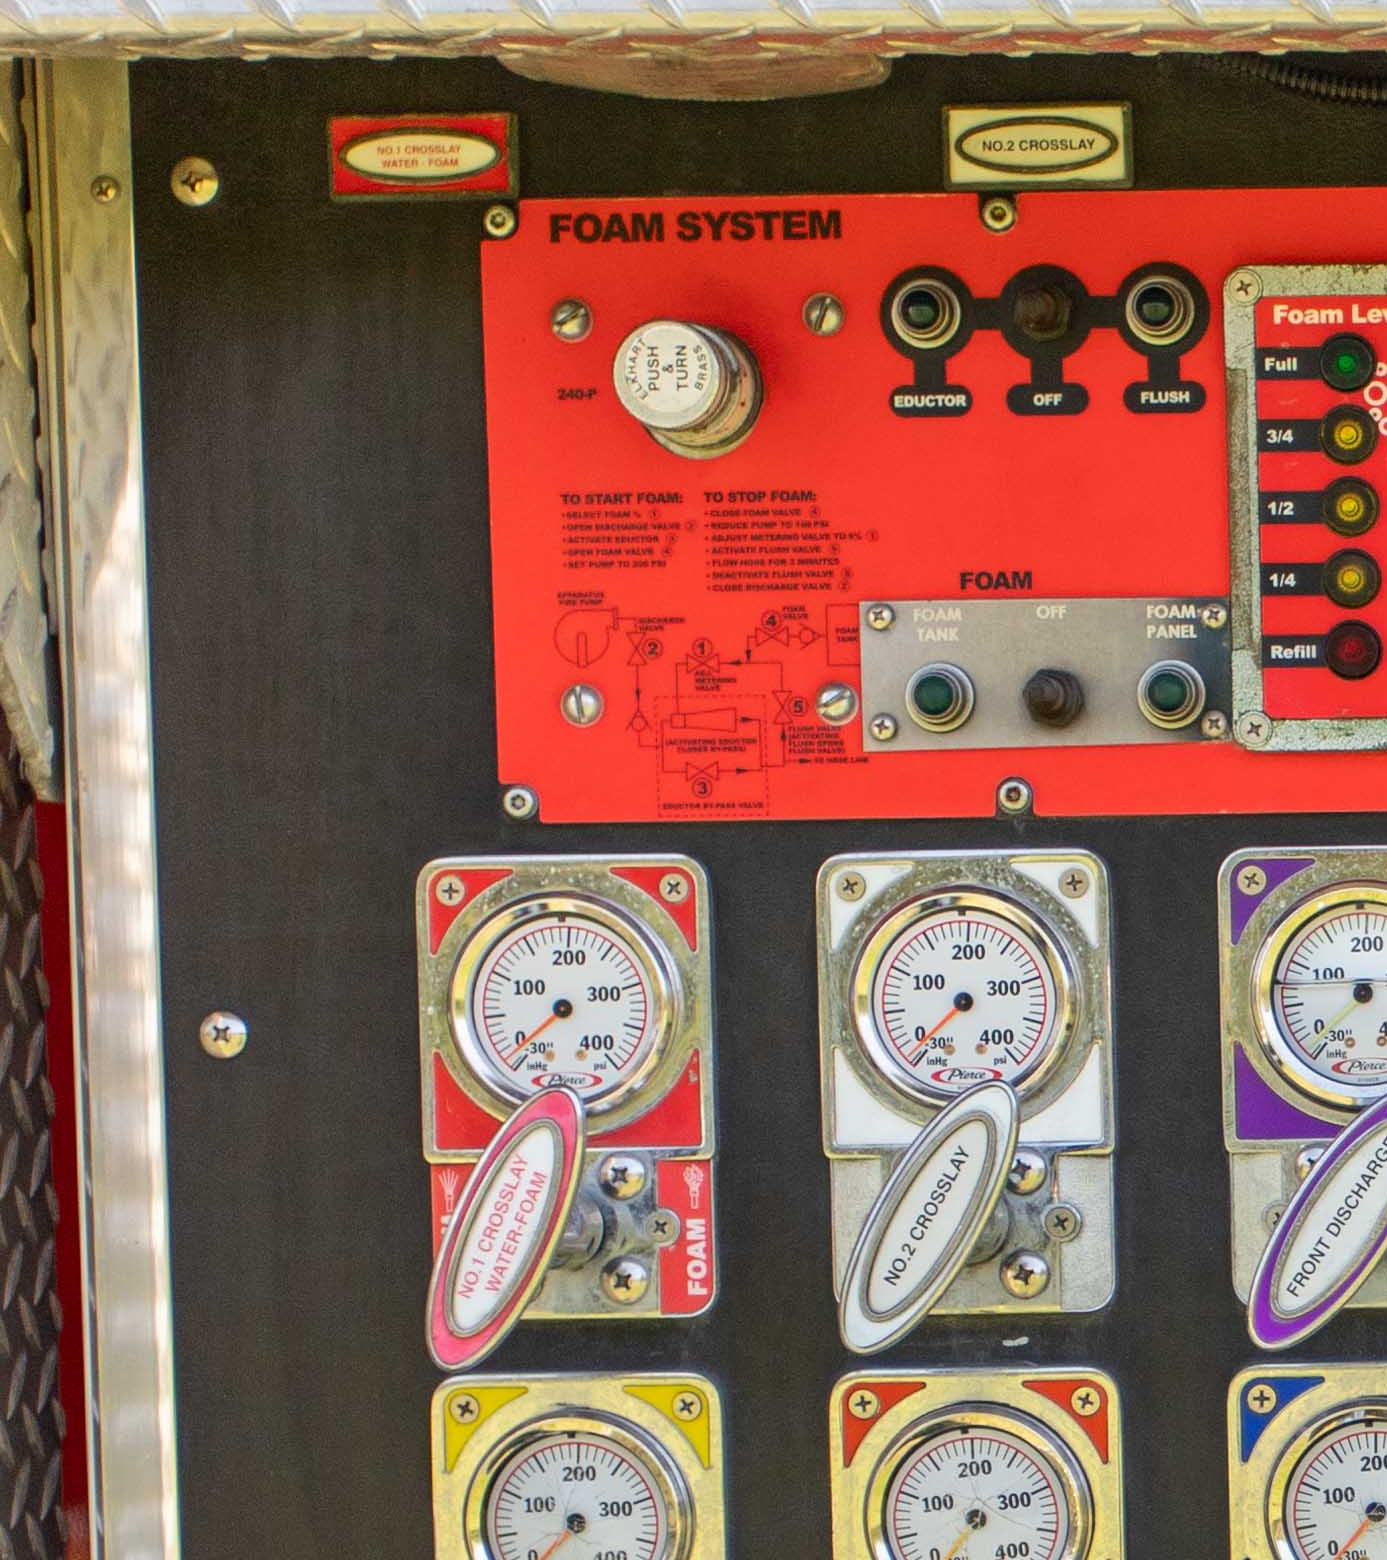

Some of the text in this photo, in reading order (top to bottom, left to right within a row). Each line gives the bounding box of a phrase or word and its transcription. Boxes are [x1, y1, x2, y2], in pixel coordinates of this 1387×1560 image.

[404, 144, 461, 155] CROSSLAY
[982, 137, 1095, 152] NO.2 CROSSLAY
[550, 210, 841, 243] FOAM SYSTEM
[1273, 305, 1343, 324] Foam
[647, 345, 660, 391] PUSH
[676, 345, 688, 391] TURN
[1265, 357, 1297, 371] Full
[894, 393, 966, 408] EDUCTOR
[1034, 392, 1063, 406] OFF
[1140, 391, 1190, 405] FLUSH
[1267, 429, 1293, 443] 3/4
[1268, 502, 1294, 515] 1/2
[960, 571, 1033, 590] FOAM
[1269, 573, 1296, 587] 1/4
[913, 608, 961, 622] FOAM
[1036, 606, 1066, 619] OFF
[1147, 605, 1196, 619] FOAM
[918, 627, 959, 641] TANK
[1147, 625, 1197, 639] PANEL
[1271, 645, 1316, 659] Refill
[552, 950, 585, 966] 200
[884, 1145, 970, 1286] NO.2 CROSSLAY
[458, 1154, 528, 1299] NO.1 CROSSLAY
[485, 1170, 546, 1293] WATER-FOAM
[687, 1217, 707, 1296] FOAM
[1286, 1238, 1327, 1298] FRONT
